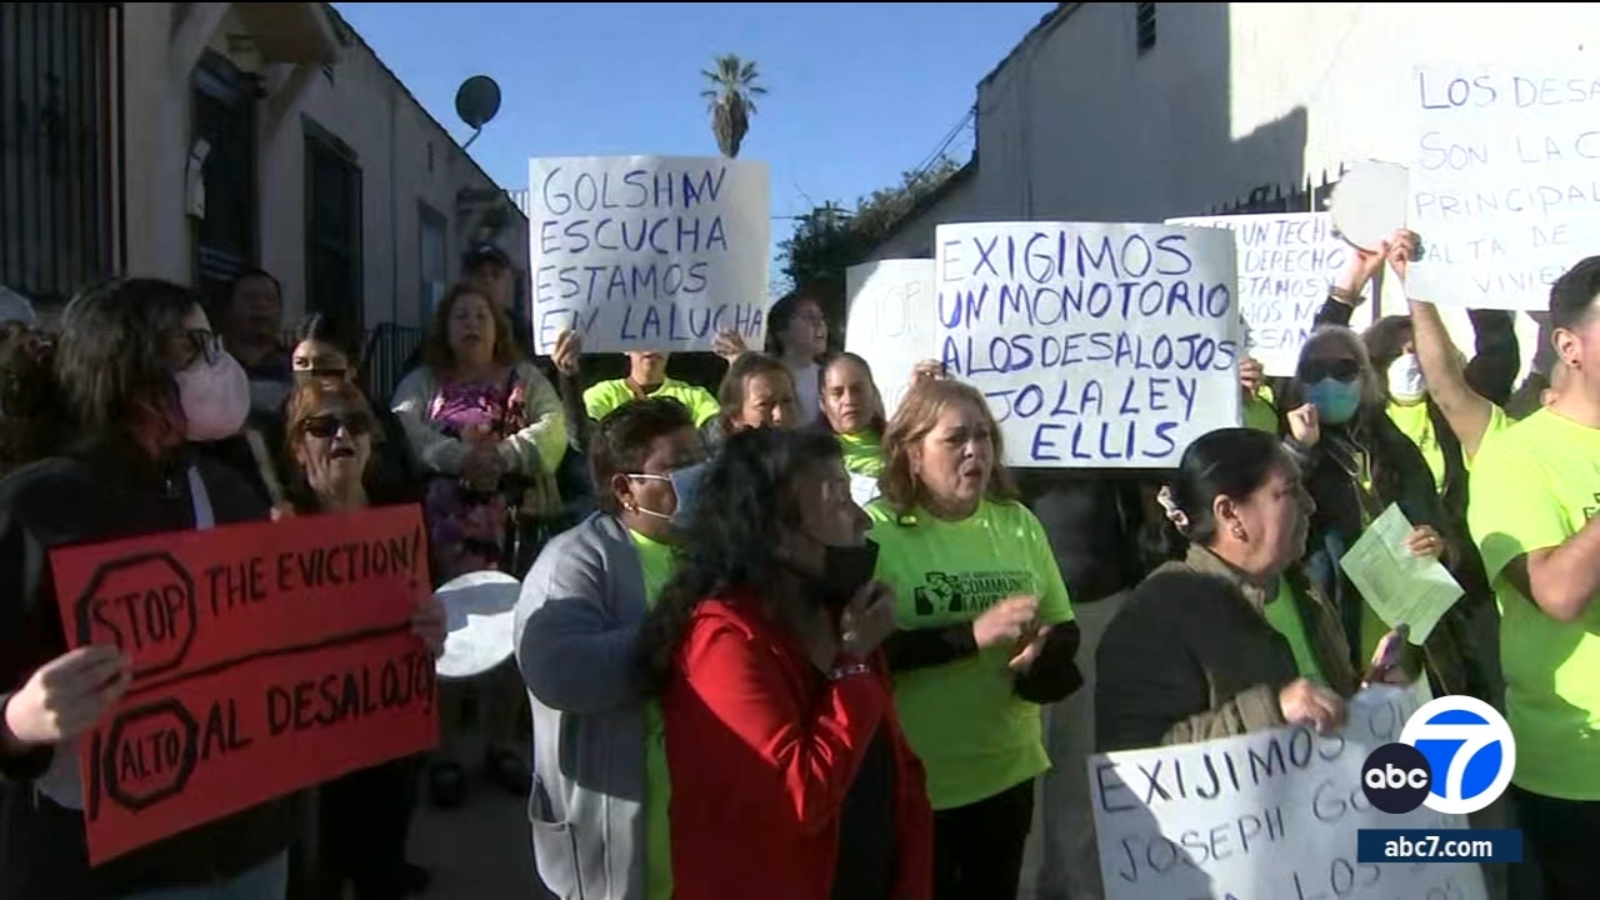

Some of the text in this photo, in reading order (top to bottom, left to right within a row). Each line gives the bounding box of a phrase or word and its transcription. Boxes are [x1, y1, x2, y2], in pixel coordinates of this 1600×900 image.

[1420, 72, 1496, 109] LOS
[1420, 132, 1488, 170] SON
[1517, 136, 1562, 163] LA
[541, 216, 727, 254] ESCUCHA
[1275, 217, 1326, 246] TECH
[1532, 224, 1571, 248] DE
[943, 231, 1192, 283] EXIGIMOS
[537, 262, 707, 303] ESTAMOS
[540, 307, 599, 348] EN
[1119, 378, 1197, 420] LEY
[1031, 421, 1180, 462] ELLIS
[93, 524, 420, 650] STOP THE EVICTION!
[202, 699, 253, 760] AL
